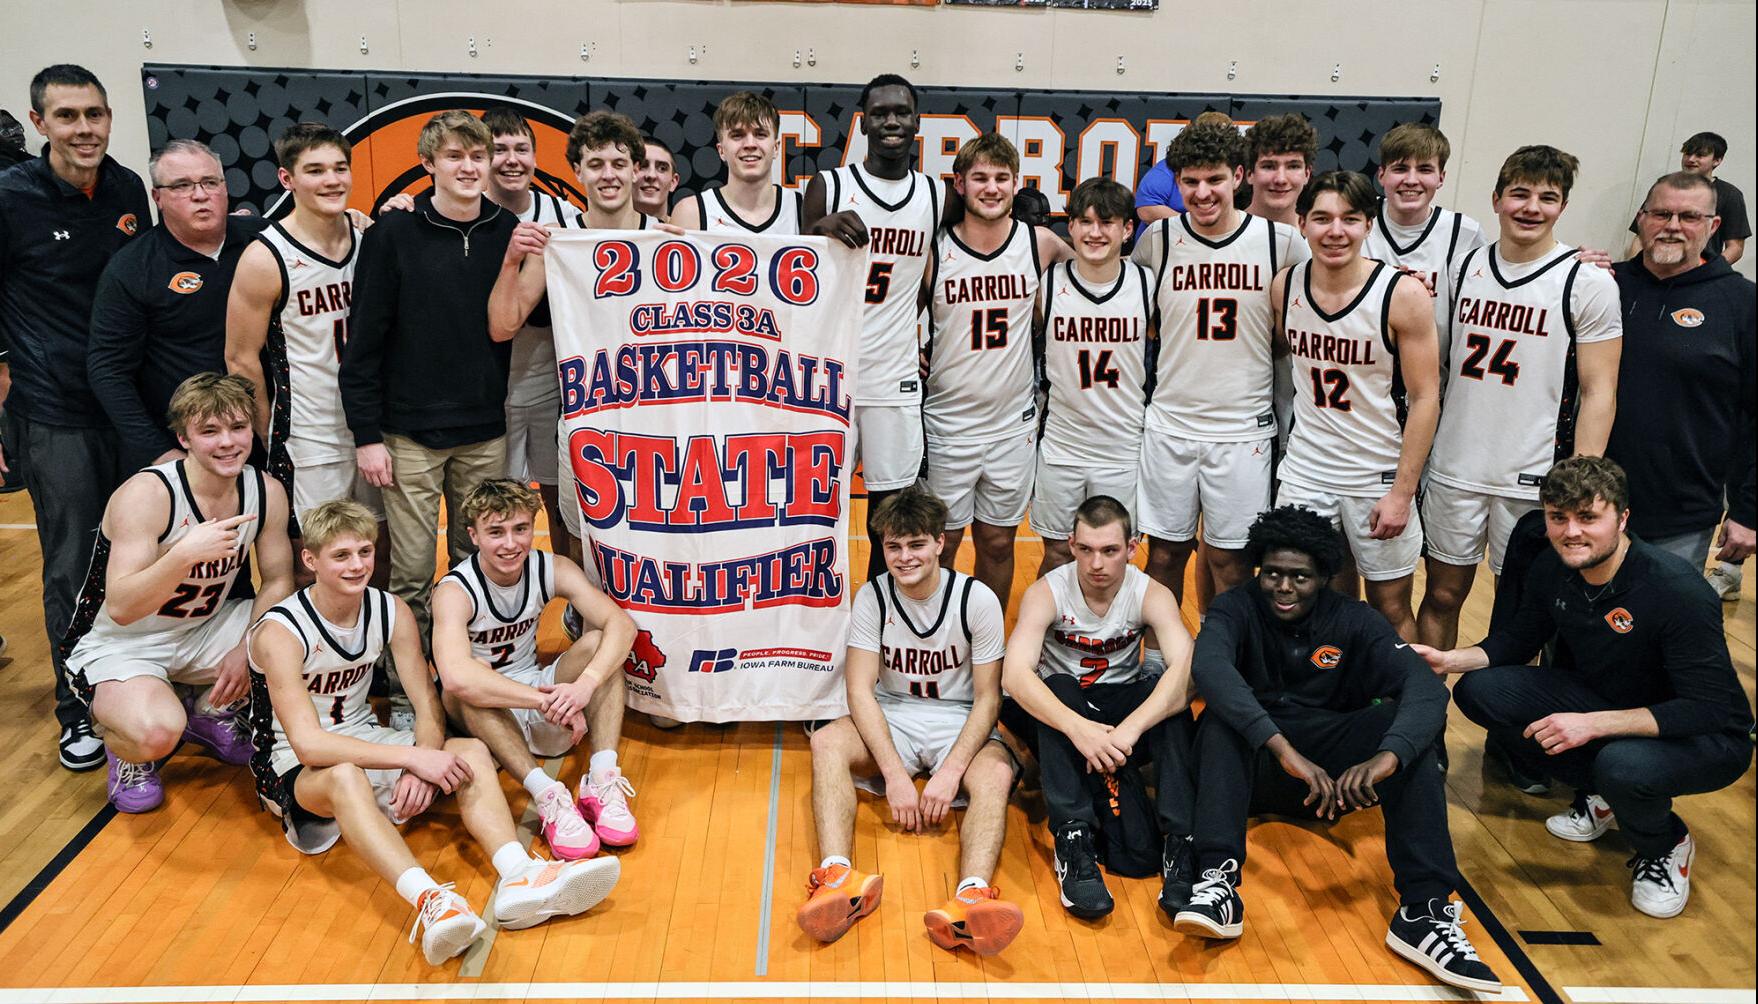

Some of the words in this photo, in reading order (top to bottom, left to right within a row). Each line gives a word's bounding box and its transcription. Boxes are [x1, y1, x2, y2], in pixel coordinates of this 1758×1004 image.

[870, 227, 925, 257] RROLL
[592, 239, 820, 306] 2026
[864, 261, 896, 305] 5
[944, 274, 1032, 304] CARROLL
[1172, 263, 1264, 291] CARROLL
[297, 281, 352, 316] CARR
[1196, 297, 1238, 341] 13
[1458, 297, 1550, 338] CARROLL
[629, 301, 735, 336] CLASS
[735, 306, 782, 342] 3A
[970, 307, 1009, 352] 15
[1053, 316, 1141, 343] CARROLL
[1287, 329, 1376, 365] CARROLL
[1460, 332, 1520, 387] 24
[559, 339, 852, 428] BASKETBALL
[1077, 349, 1120, 390] 14
[1311, 366, 1352, 413] 12
[568, 427, 845, 534] STATE
[588, 534, 844, 616] UALIFIER
[156, 581, 226, 619] 23
[740, 661, 766, 670] IOWA
[768, 660, 796, 668] FARM
[797, 661, 834, 672] BUREAU
[880, 645, 964, 675] CARROLL
